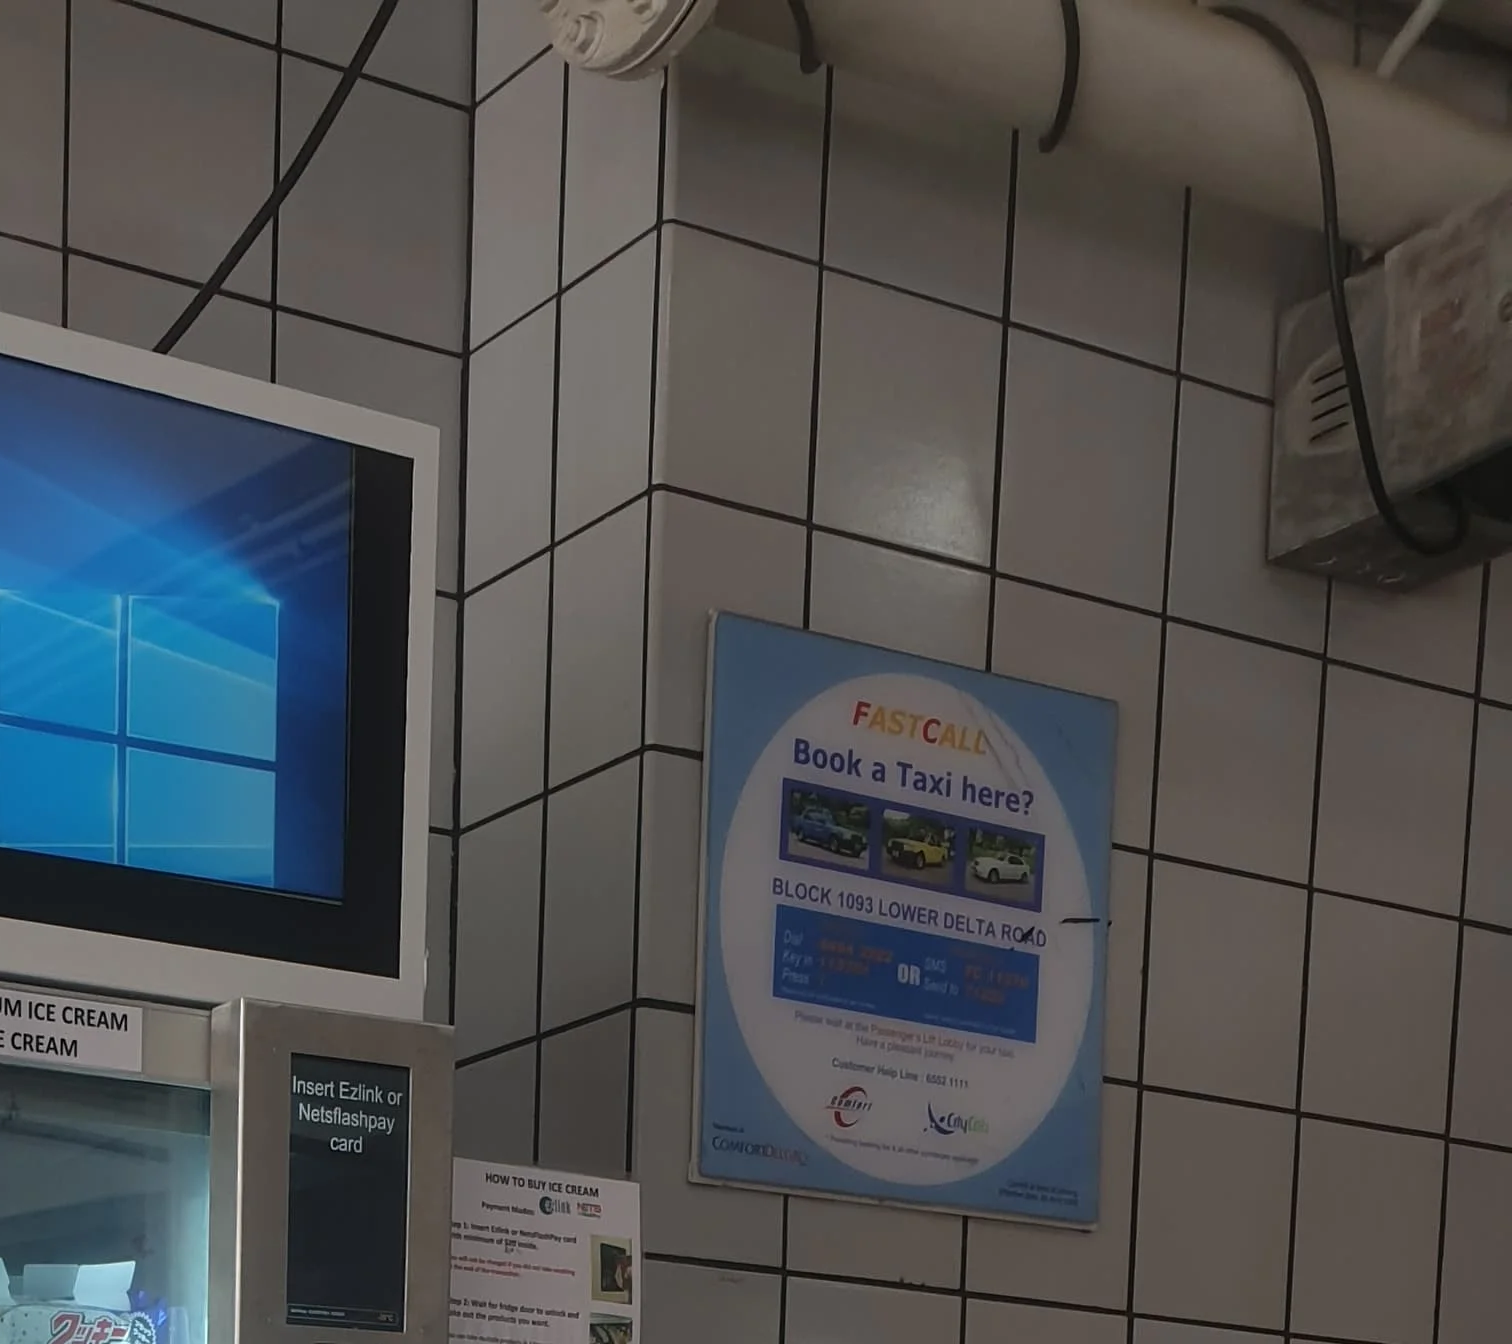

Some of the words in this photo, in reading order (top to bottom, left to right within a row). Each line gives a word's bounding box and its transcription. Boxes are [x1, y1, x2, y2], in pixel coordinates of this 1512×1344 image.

[852, 701, 988, 755] FASTCALL
[793, 738, 862, 777] Book
[871, 763, 886, 783] a
[896, 761, 952, 797] Taxi
[962, 776, 1034, 815] here?
[772, 877, 832, 905] BLOCK
[838, 891, 874, 914] 1093
[879, 902, 938, 926] LOWER
[944, 912, 996, 937] DELTA
[1002, 924, 1047, 947] ROAD
[897, 963, 921, 986] OR
[27, 1000, 56, 1023] ICE
[61, 1006, 129, 1032] CREAM
[10, 1031, 79, 1058] CREAM
[831, 1056, 875, 1074] Customer
[877, 1064, 898, 1079] Help
[900, 1068, 918, 1082] Line
[292, 1075, 335, 1098] Insert
[339, 1081, 384, 1103] Ezlink
[387, 1090, 403, 1106] or
[298, 1103, 396, 1134] Netsflashpay
[330, 1136, 363, 1154] card
[485, 1173, 510, 1185] HOW
[511, 1176, 525, 1187] TO
[528, 1179, 546, 1190] BUY
[548, 1181, 563, 1193] ICE
[565, 1184, 599, 1198] CREAM
